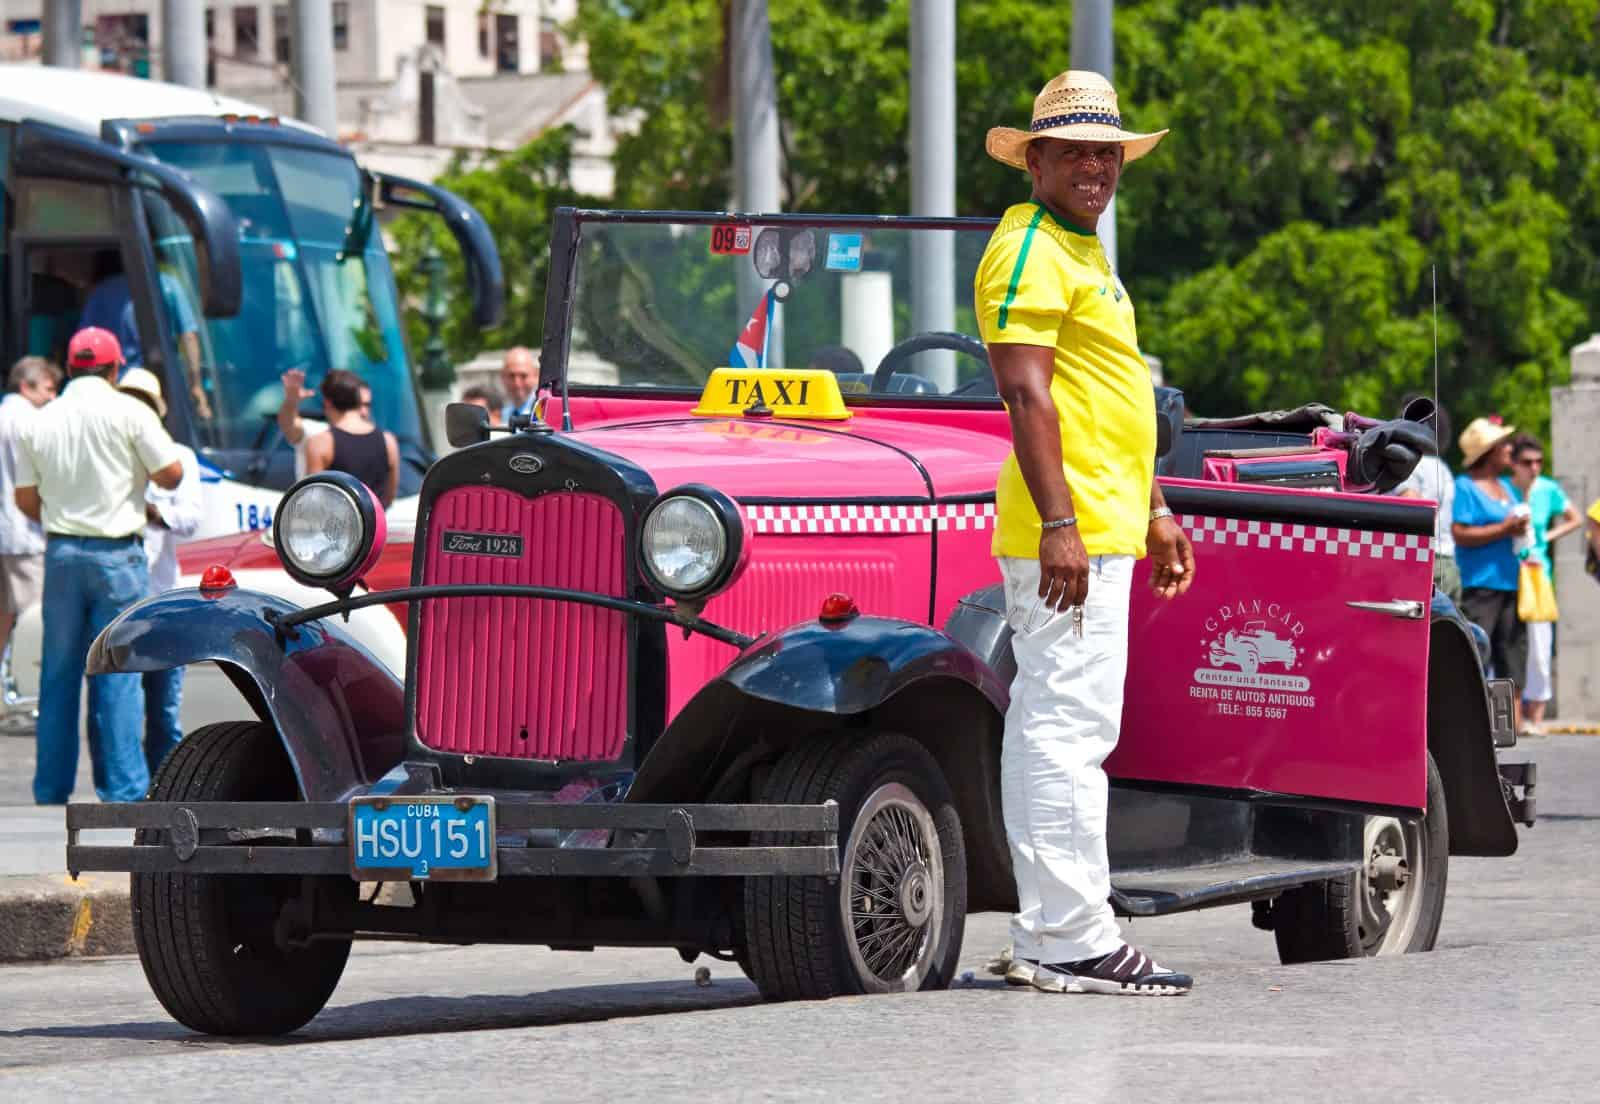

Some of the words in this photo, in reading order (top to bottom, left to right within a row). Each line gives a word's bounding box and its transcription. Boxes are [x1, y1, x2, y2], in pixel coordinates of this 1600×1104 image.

[713, 227, 735, 250] 09
[726, 379, 811, 406] TAXI
[449, 535, 482, 552] Ford
[486, 538, 517, 553] 1928
[1259, 676, 1304, 689] fantasia
[1189, 686, 1219, 699] RENTA
[1221, 689, 1233, 701] DE
[1235, 690, 1266, 703] AUTOS
[1268, 693, 1315, 708] ANTIGUOS
[1265, 707, 1287, 720] 5567
[407, 804, 440, 817] CUBA
[421, 860, 428, 873] 3
